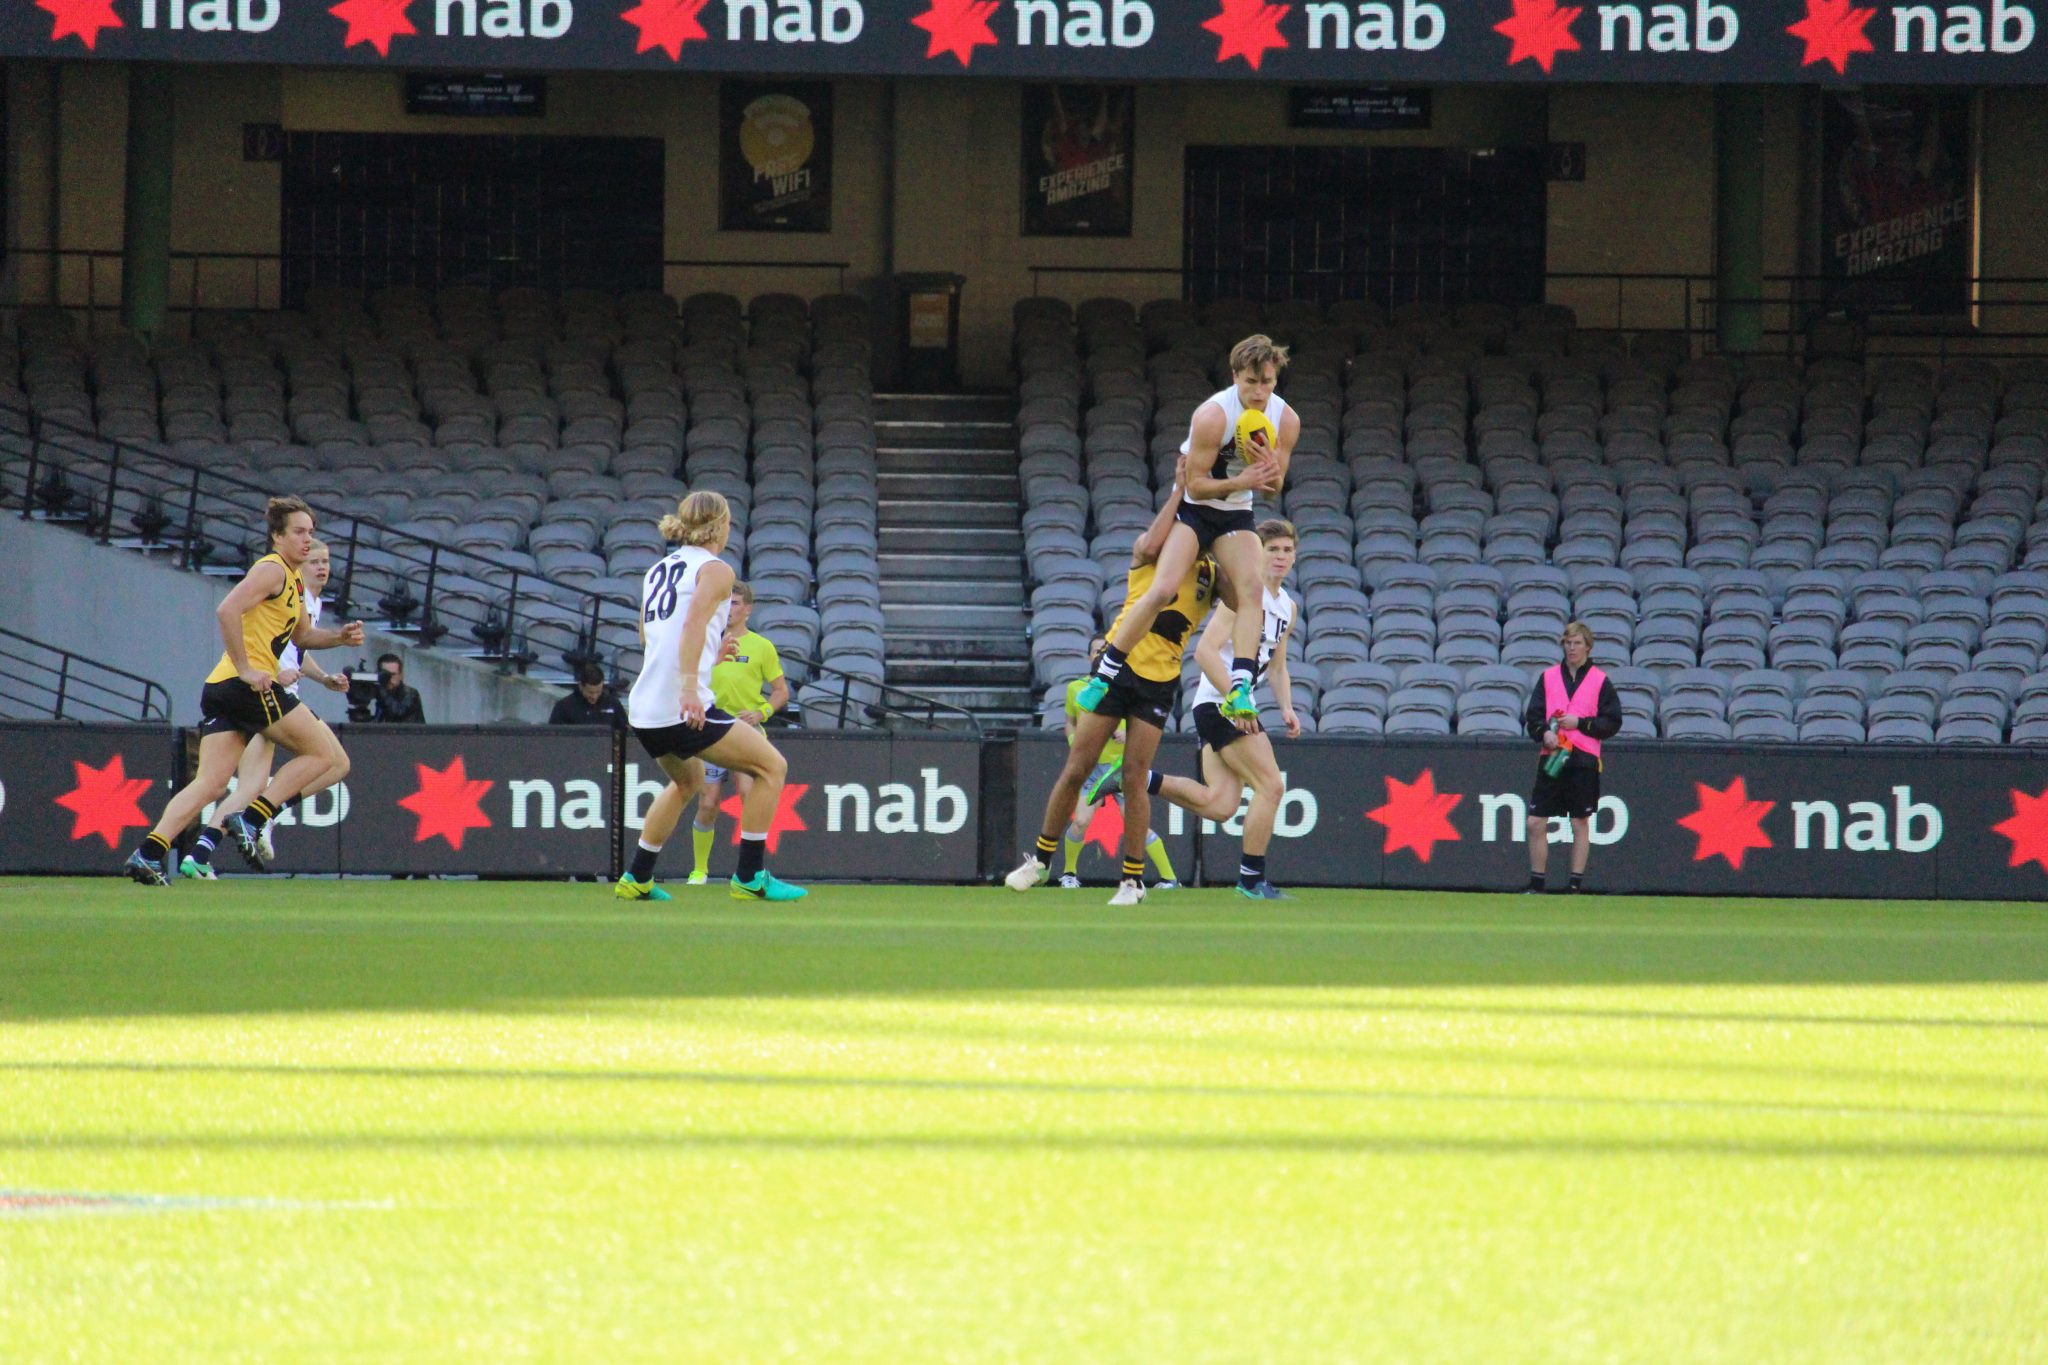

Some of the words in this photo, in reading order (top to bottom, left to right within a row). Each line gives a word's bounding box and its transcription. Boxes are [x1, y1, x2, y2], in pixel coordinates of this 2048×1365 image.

[724, 0, 864, 44] nab
[1015, 0, 1154, 48] nab
[1306, 0, 1445, 52] nab
[1597, 0, 1738, 52] nab
[1892, 0, 2034, 54] nab
[772, 168, 811, 197] WIFI
[1039, 153, 1126, 192] EXPERIENCE
[1046, 174, 1111, 206] AMAZING
[1834, 196, 1967, 258] EXPERIENCE
[1846, 228, 1944, 277] AMAZING
[644, 561, 688, 624] 28
[824, 767, 969, 834] nab
[1791, 785, 1942, 852] nab
